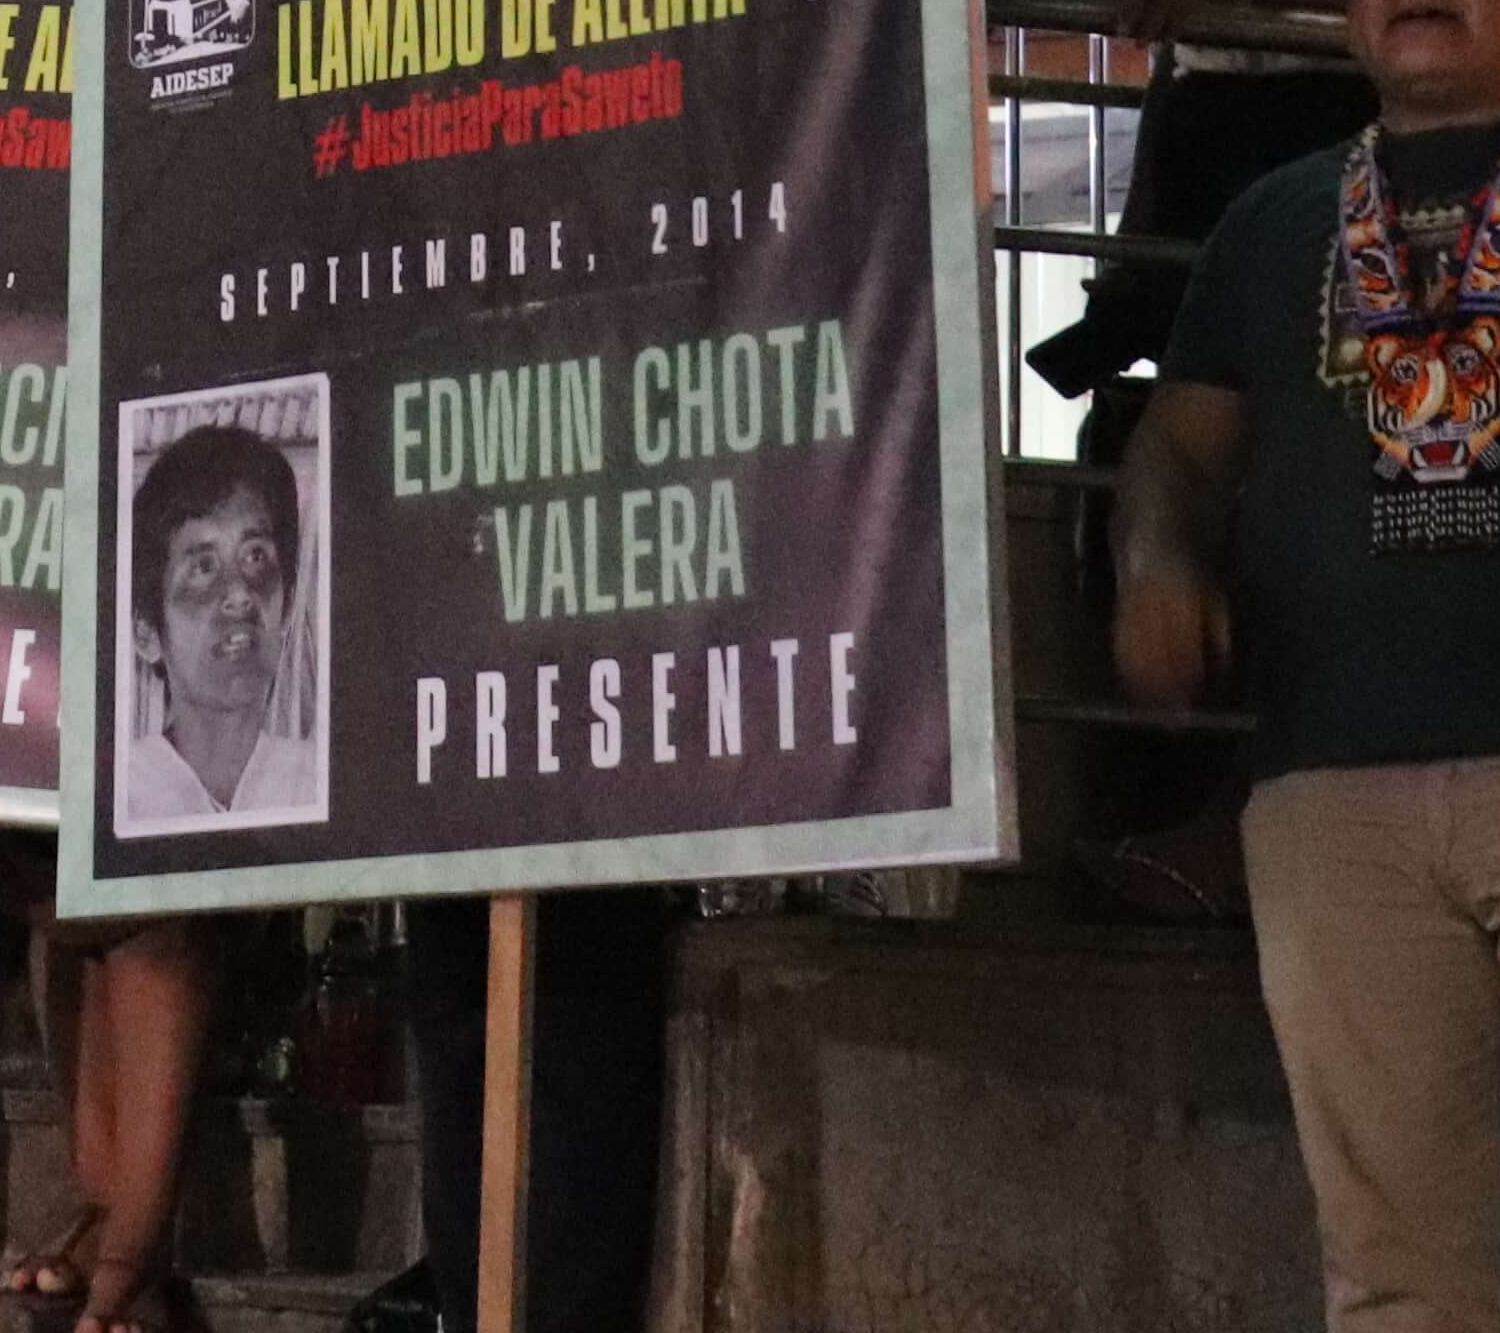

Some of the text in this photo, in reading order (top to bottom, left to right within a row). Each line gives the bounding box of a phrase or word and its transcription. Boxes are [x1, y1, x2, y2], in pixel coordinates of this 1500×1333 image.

[150, 62, 235, 99] AIDESEP
[312, 51, 684, 180] #JusticiaParaSaweto
[220, 181, 787, 322] SEPTIEMBRE, 2014
[393, 318, 856, 499] EDWIN CHOTA
[494, 478, 747, 624] VALERA
[416, 632, 858, 785] PRESENTE
